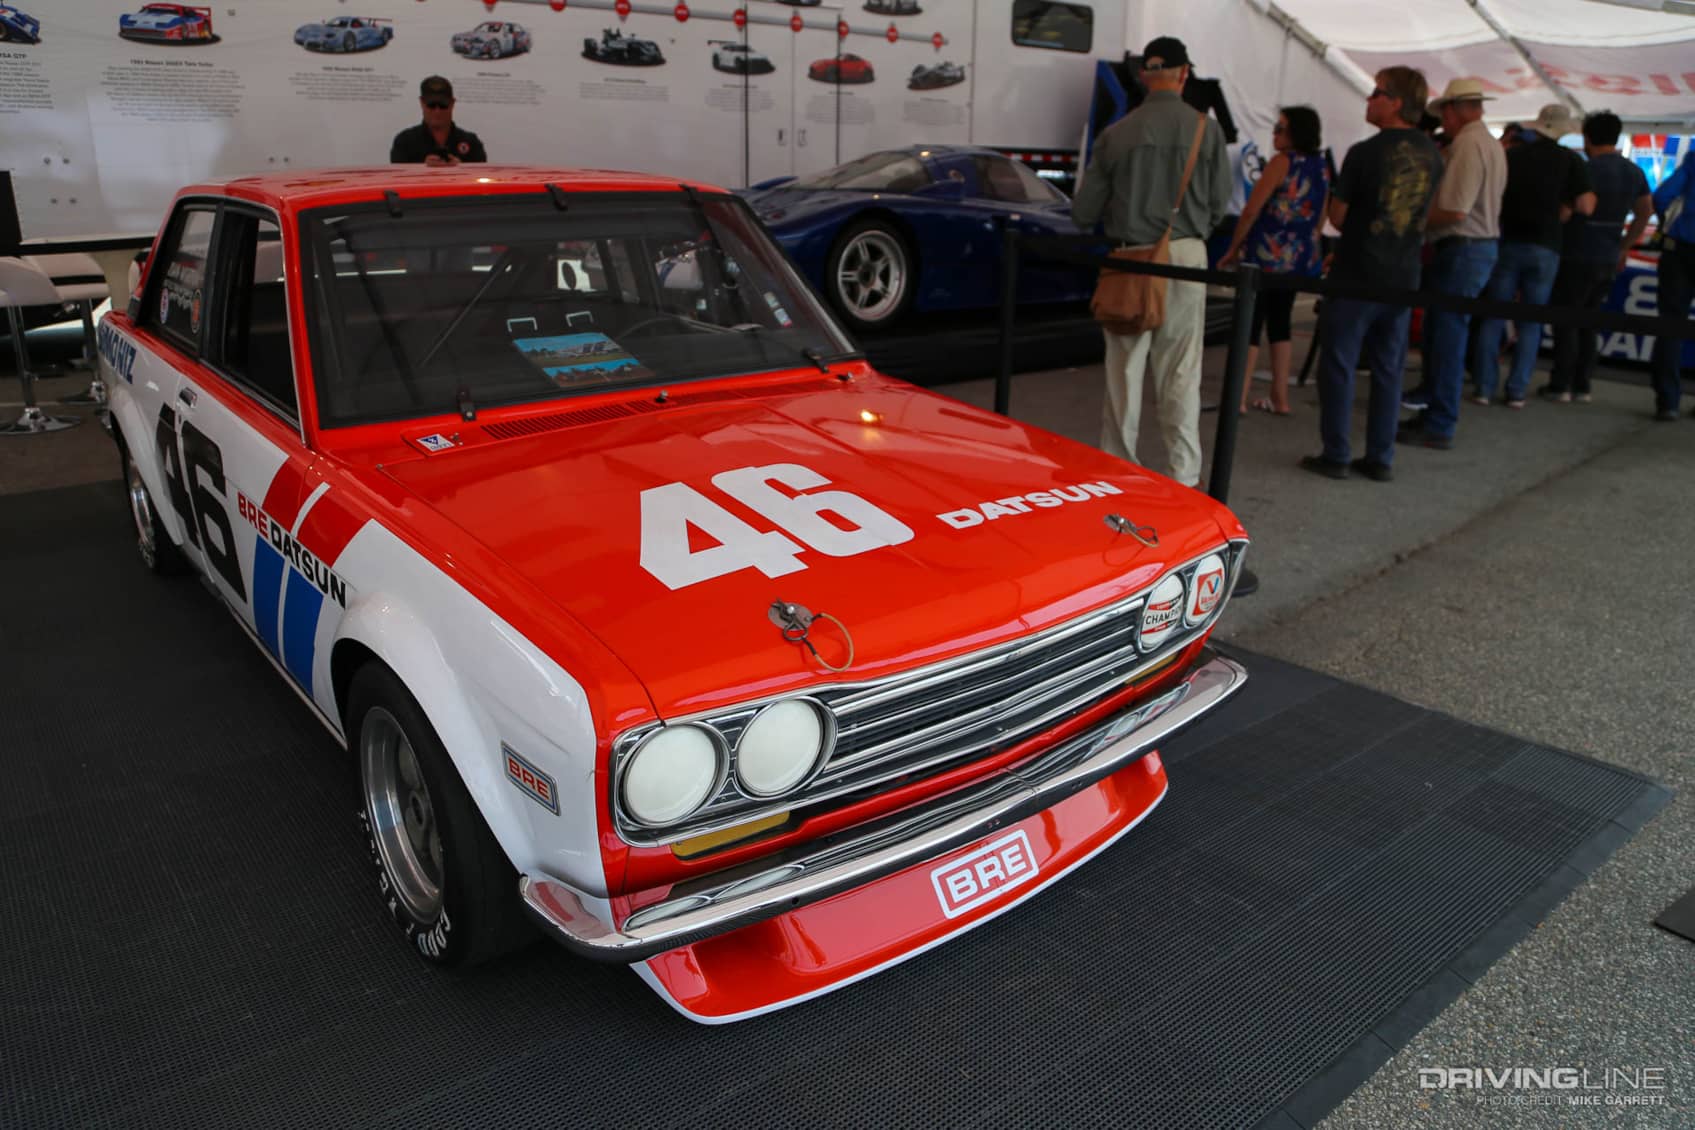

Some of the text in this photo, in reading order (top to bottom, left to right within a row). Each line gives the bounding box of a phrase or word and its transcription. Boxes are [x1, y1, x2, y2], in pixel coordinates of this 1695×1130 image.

[156, 403, 248, 605] 46
[639, 463, 915, 591] 46
[936, 481, 1125, 530] DATSUN
[237, 491, 347, 611] BRE DATSUN
[508, 757, 550, 800] BRE
[945, 843, 1027, 904] BRE
